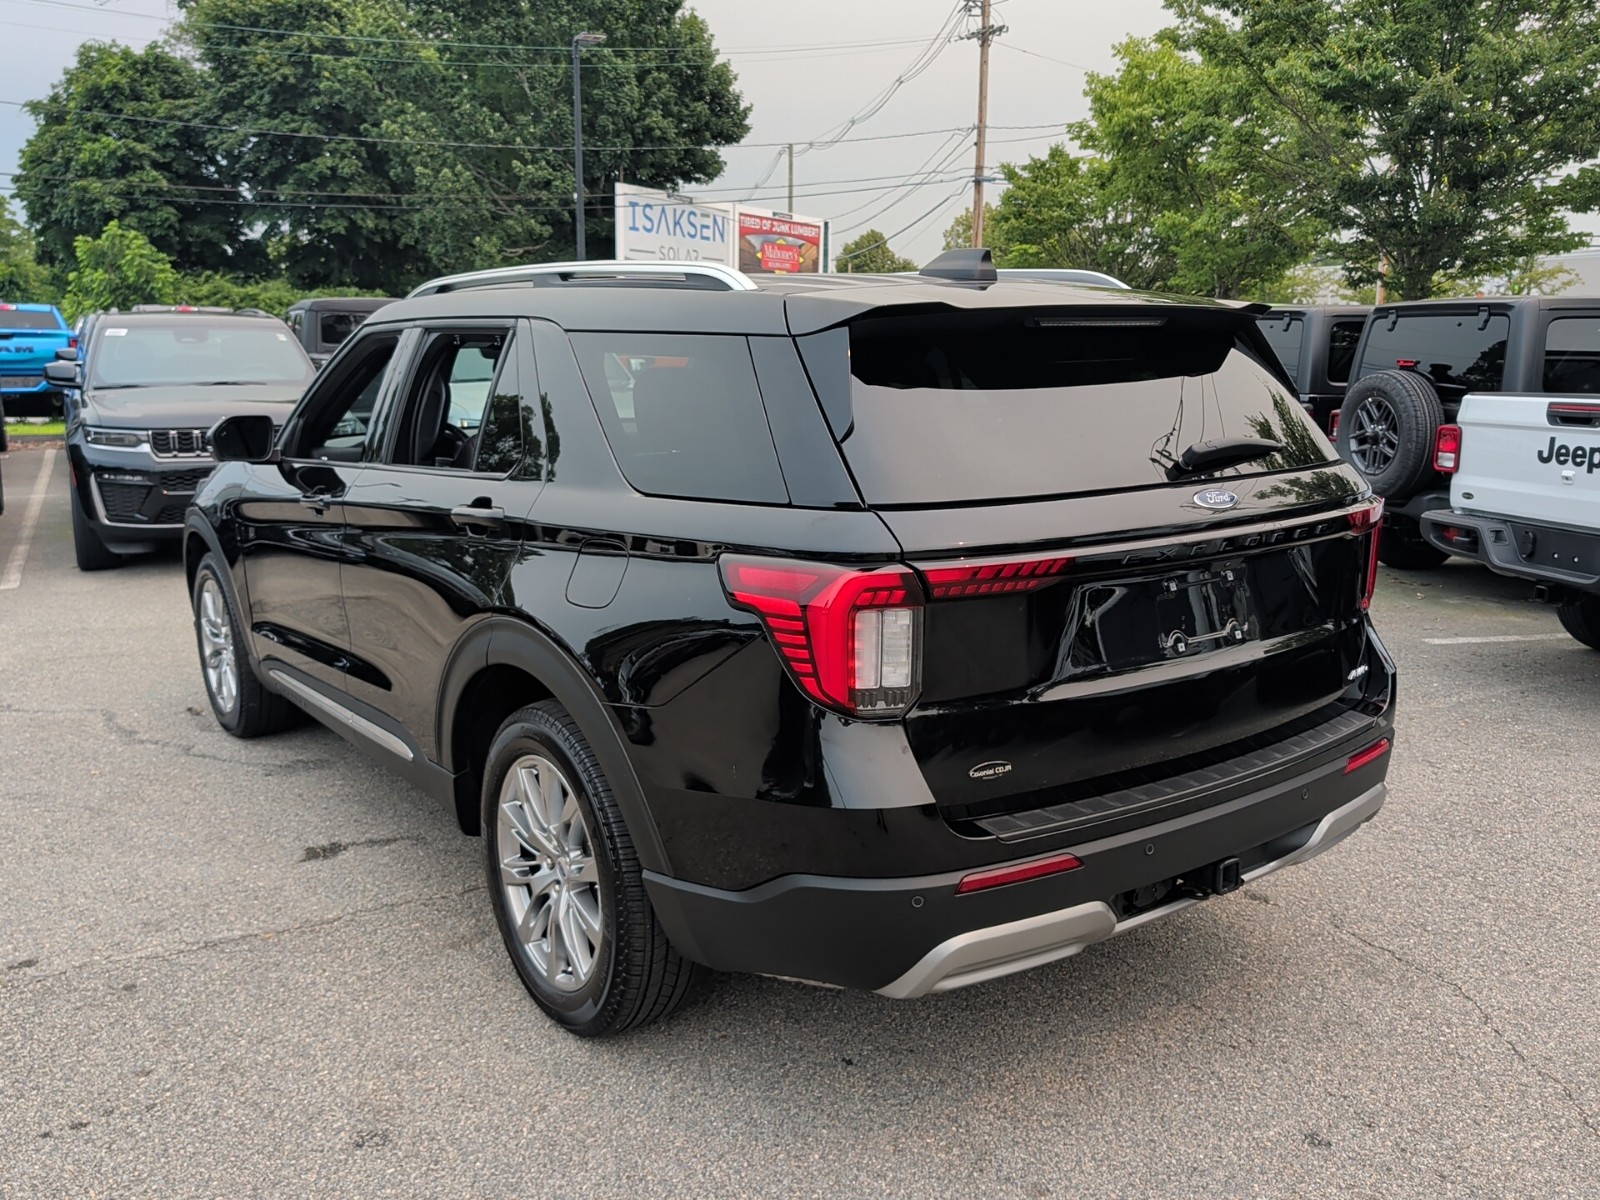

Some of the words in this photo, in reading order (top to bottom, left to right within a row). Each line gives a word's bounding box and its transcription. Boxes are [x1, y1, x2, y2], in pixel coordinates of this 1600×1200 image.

[628, 200, 725, 244] ISAKSEN
[762, 219, 772, 231] OF
[659, 245, 700, 260] SOLAR
[1537, 436, 1600, 474] Jeep
[1205, 491, 1230, 504] Ford
[1120, 522, 1335, 566] EXPLORER
[970, 768, 994, 777] Colonial
